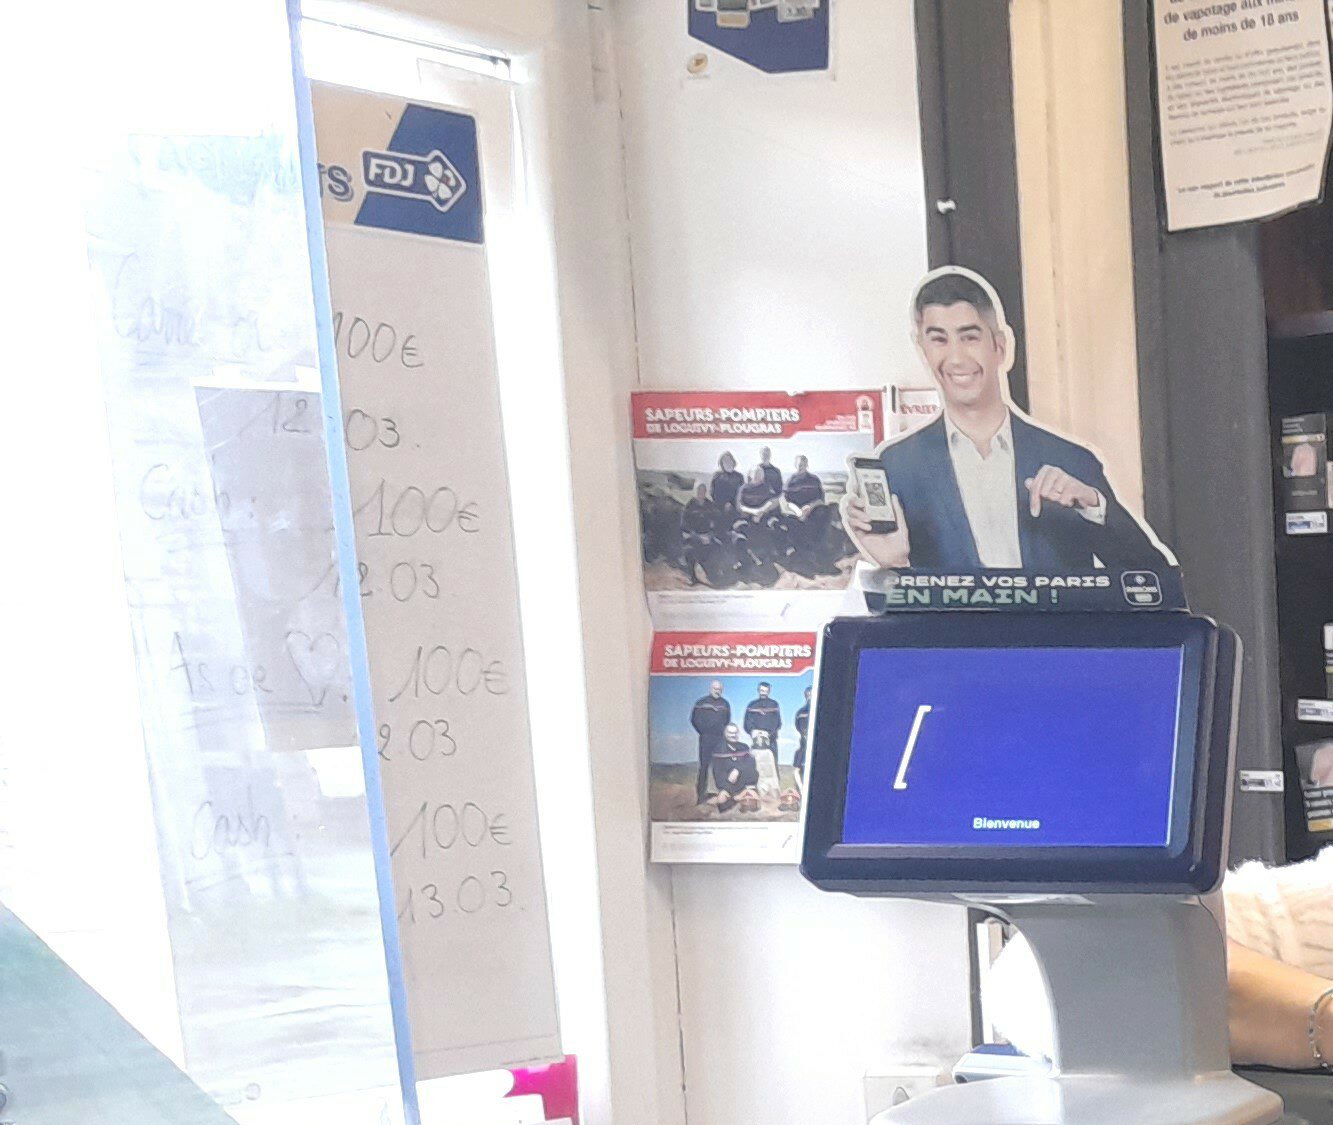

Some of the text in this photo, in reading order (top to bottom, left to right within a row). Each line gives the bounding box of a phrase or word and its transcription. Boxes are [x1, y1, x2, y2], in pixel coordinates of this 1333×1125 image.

[1164, 11, 1180, 25] de
[1183, 12, 1299, 42] de moins de 18 ans
[368, 158, 415, 187] FDJ
[982, 574, 1029, 588] VOS
[1035, 574, 1110, 588] PARIS
[886, 588, 1038, 605] EN MAIN
[389, 646, 509, 702] 100€
[391, 801, 512, 858] 100€
[973, 816, 1040, 831] Bienvenue
